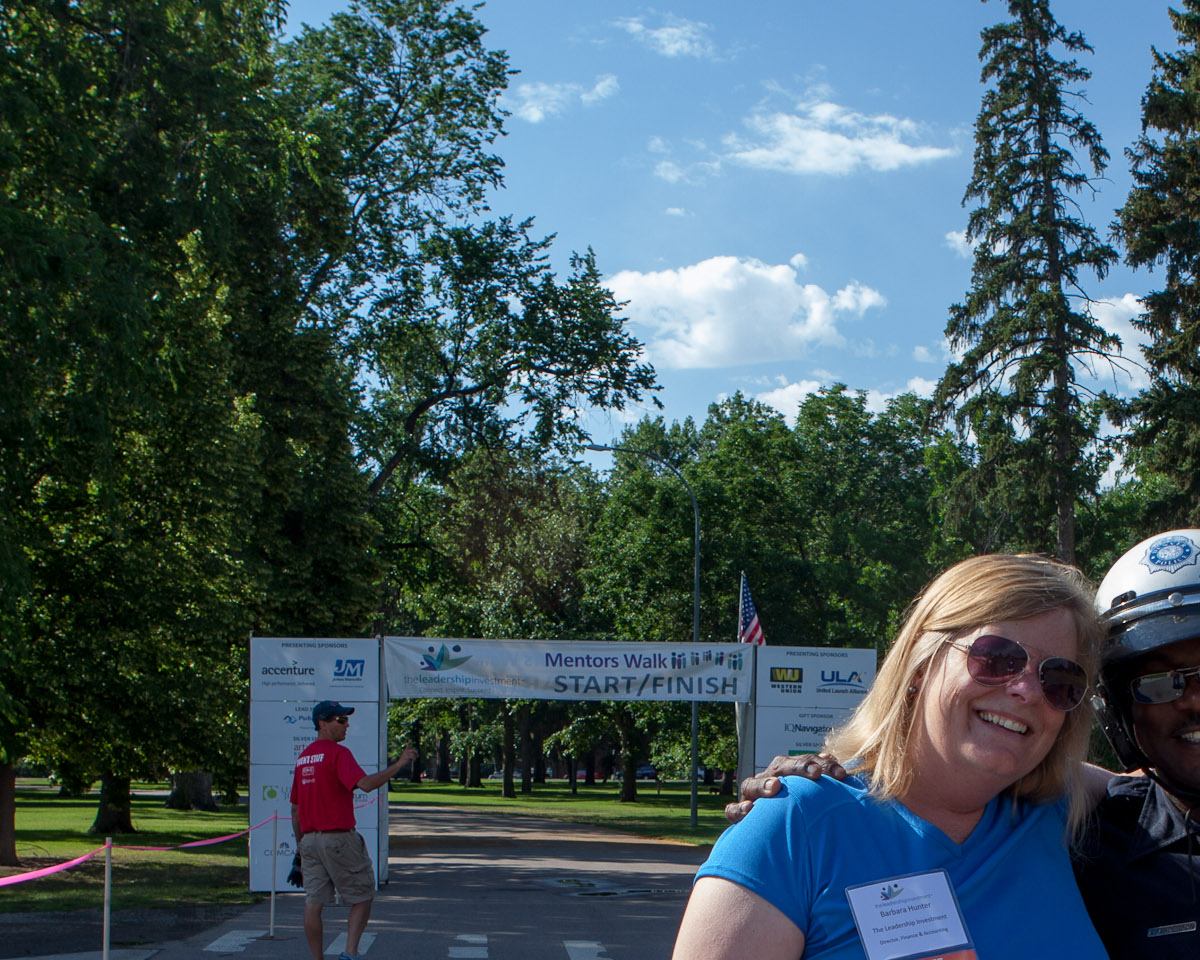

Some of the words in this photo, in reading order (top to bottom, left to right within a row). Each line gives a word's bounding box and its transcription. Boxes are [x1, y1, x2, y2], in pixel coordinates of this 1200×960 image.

[1155, 555, 1187, 565] POLICE
[545, 652, 620, 669] Mentors
[623, 653, 668, 669] Walk
[261, 664, 315, 676] accenture
[821, 670, 862, 683] ULA
[554, 674, 738, 697] START/FINISH
[310, 753, 325, 764] STAFF
[879, 907, 908, 918] Barbara
[907, 902, 932, 912] Hunter
[884, 920, 916, 931] Leadership
[916, 914, 948, 925] Investment
[900, 933, 918, 941] Finance
[923, 927, 949, 936] Accounting
